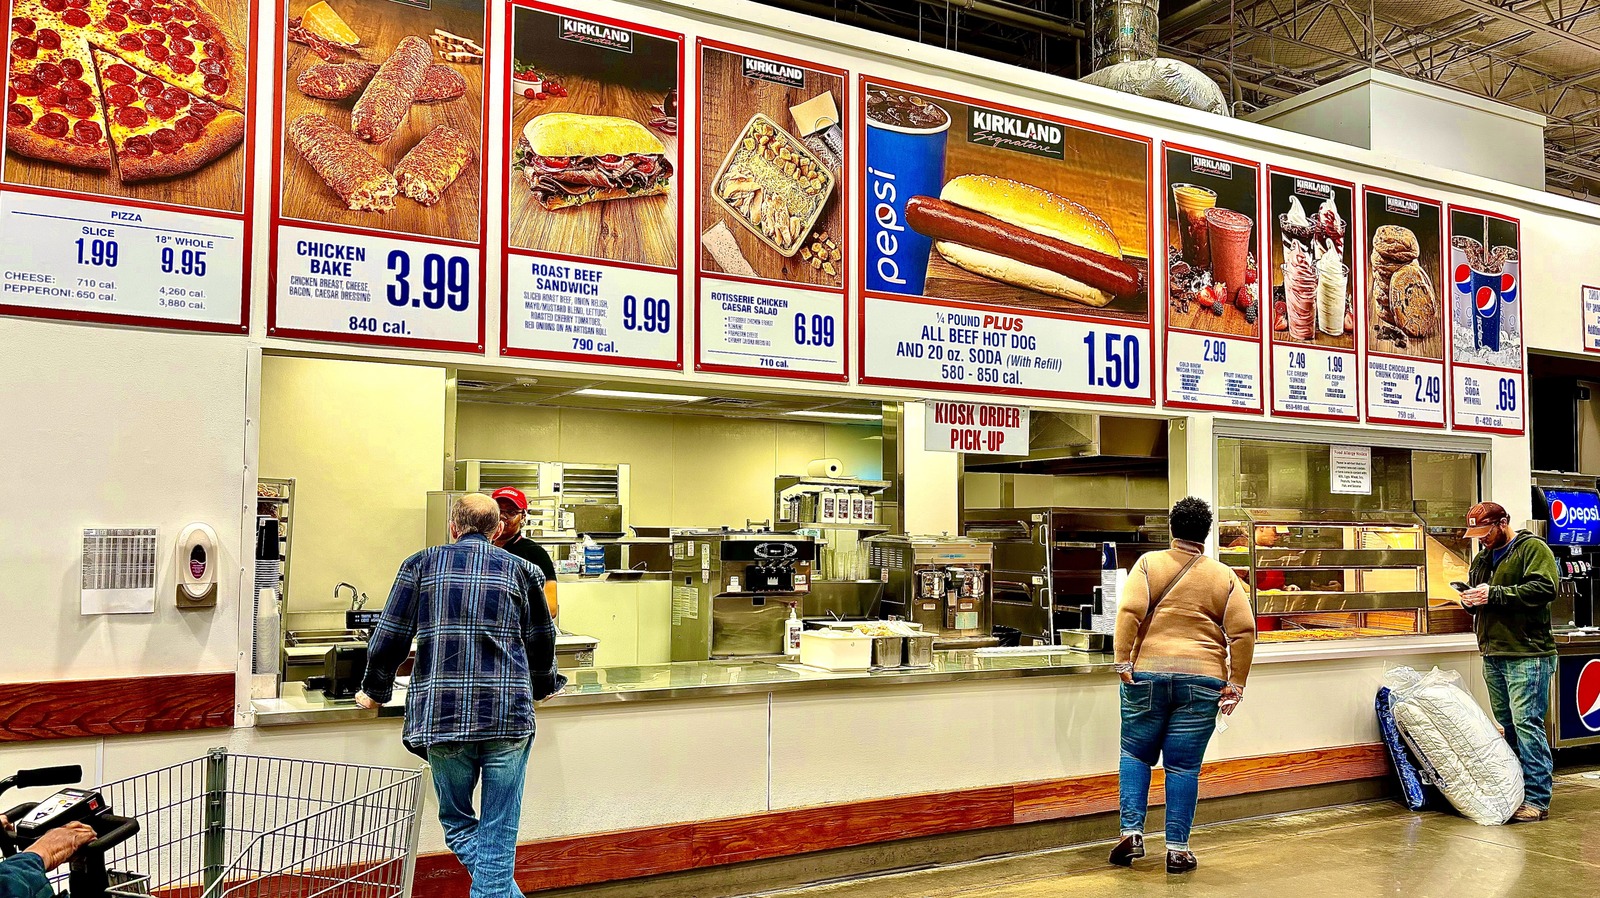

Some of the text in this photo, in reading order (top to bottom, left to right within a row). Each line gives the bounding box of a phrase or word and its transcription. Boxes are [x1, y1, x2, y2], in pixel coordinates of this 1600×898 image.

[564, 19, 630, 43] KIRKLAND
[746, 58, 802, 80] KIRKLAND
[973, 111, 1061, 144] KIRKLAND
[973, 131, 1060, 153] Signature
[1194, 156, 1230, 172] KIRKLAND
[1297, 180, 1330, 192] KIRKLAND
[1388, 198, 1418, 210] KIRKLAND
[111, 211, 142, 222] PIZZA
[82, 226, 114, 237] SLICE
[868, 167, 906, 284] pepsi
[176, 237, 213, 248] WHOLE
[297, 241, 365, 261] CHICKEN
[75, 238, 118, 267] 1.99
[162, 247, 206, 276] 9.95
[311, 259, 352, 277] BAKE
[4, 271, 117, 289] CHEESE: 710 cal.
[387, 250, 469, 311] 3.99
[532, 264, 602, 282] ROAST BEEF
[291, 276, 369, 291] CHICKEN BREAST, CHEESE,
[537, 278, 598, 295] SANDWICH
[4, 284, 116, 301] PEPPERONI: 650 cal.
[159, 287, 206, 298] 4,260 cal.
[290, 286, 371, 302] BACON, CAESAR DRESSING
[542, 293, 558, 302] ROAST
[711, 292, 788, 308] ROTISSERIE CHICKEN
[159, 299, 206, 309] 3,880 cal.
[525, 301, 566, 313] MAYO/MUSTARD
[722, 303, 777, 315] CAESAR SALAD
[531, 311, 553, 321] ROASTED
[555, 314, 573, 323] CHERRY
[624, 295, 670, 333] 9.99
[948, 313, 980, 327] POUND
[983, 315, 1023, 331] PLUS
[349, 317, 410, 334] 840 cal.
[525, 321, 534, 329] RED
[557, 324, 563, 332] ON
[565, 324, 572, 332] AN
[573, 326, 594, 334] ARTISAN
[596, 328, 606, 336] ROLL
[795, 313, 834, 347] 6.99
[572, 338, 618, 352] 790 cal.
[921, 325, 1036, 350] ALL BEEF HOT DOG
[897, 342, 1062, 372] AND 20 oz. SODA (With Refill)
[1204, 340, 1226, 362] 2.99
[760, 358, 773, 366] 710
[1084, 331, 1139, 389] 1.50
[1289, 352, 1305, 368] 2.49
[1328, 356, 1342, 372] 1.99
[1369, 362, 1414, 373] DOUBLE CHOCOLATE
[942, 365, 964, 380] 580
[977, 368, 998, 383] 850
[1003, 371, 1022, 385] cal.
[1465, 377, 1471, 386] 20
[1415, 375, 1440, 403] 2.49
[1465, 387, 1480, 396] SODA
[1496, 378, 1515, 411] .69
[935, 403, 1019, 428] KIOSK ORDER
[951, 429, 1004, 451] PICK-UP
[1569, 505, 1600, 524] pepsi
